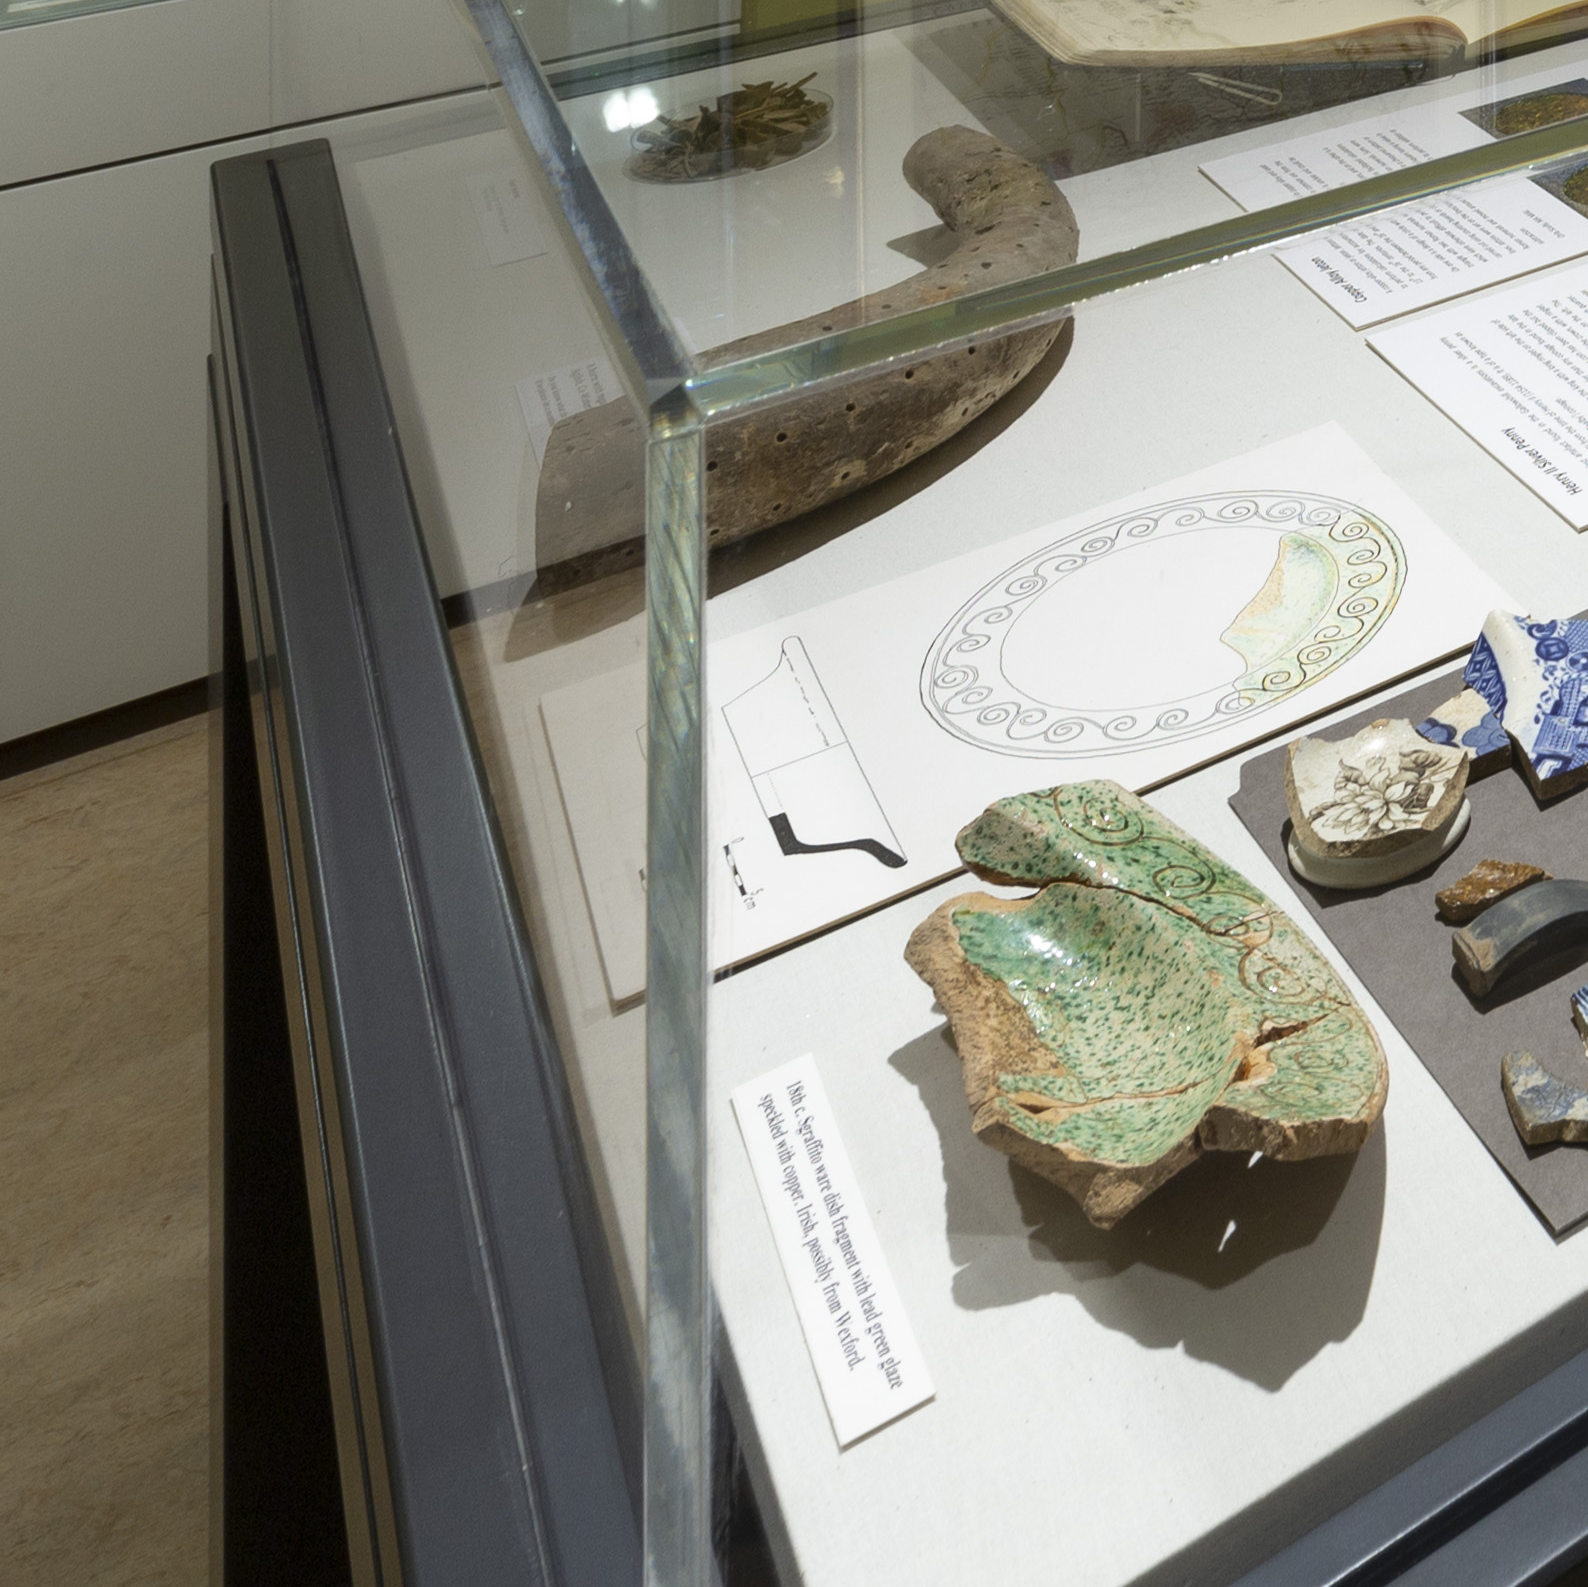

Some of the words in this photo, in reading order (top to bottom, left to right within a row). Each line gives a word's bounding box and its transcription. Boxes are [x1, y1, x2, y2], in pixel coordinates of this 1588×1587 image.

[1311, 256, 1332, 272] Jeton
[1326, 269, 1347, 284] Alloy
[1340, 283, 1367, 303] Copper
[1501, 426, 1530, 450] Penny
[1524, 447, 1552, 468] Silver
[1552, 471, 1582, 495] Henry
[785, 1080, 806, 1107] 18th
[757, 1093, 788, 1140] speckled
[793, 1106, 805, 1118] c.
[775, 1138, 795, 1165] with
[796, 1115, 823, 1164] Sgraffito
[781, 1164, 804, 1206] copper.
[814, 1163, 832, 1193] ware
[822, 1192, 844, 1218] dish
[796, 1203, 818, 1238] Irish,
[831, 1215, 860, 1270] fragment
[801, 1236, 834, 1283] possibly
[850, 1267, 872, 1296] with
[821, 1281, 841, 1314] from
[859, 1292, 883, 1323] lead
[834, 1310, 865, 1371] Wexford.
[864, 1322, 890, 1358] green
[876, 1356, 902, 1390] glaze
